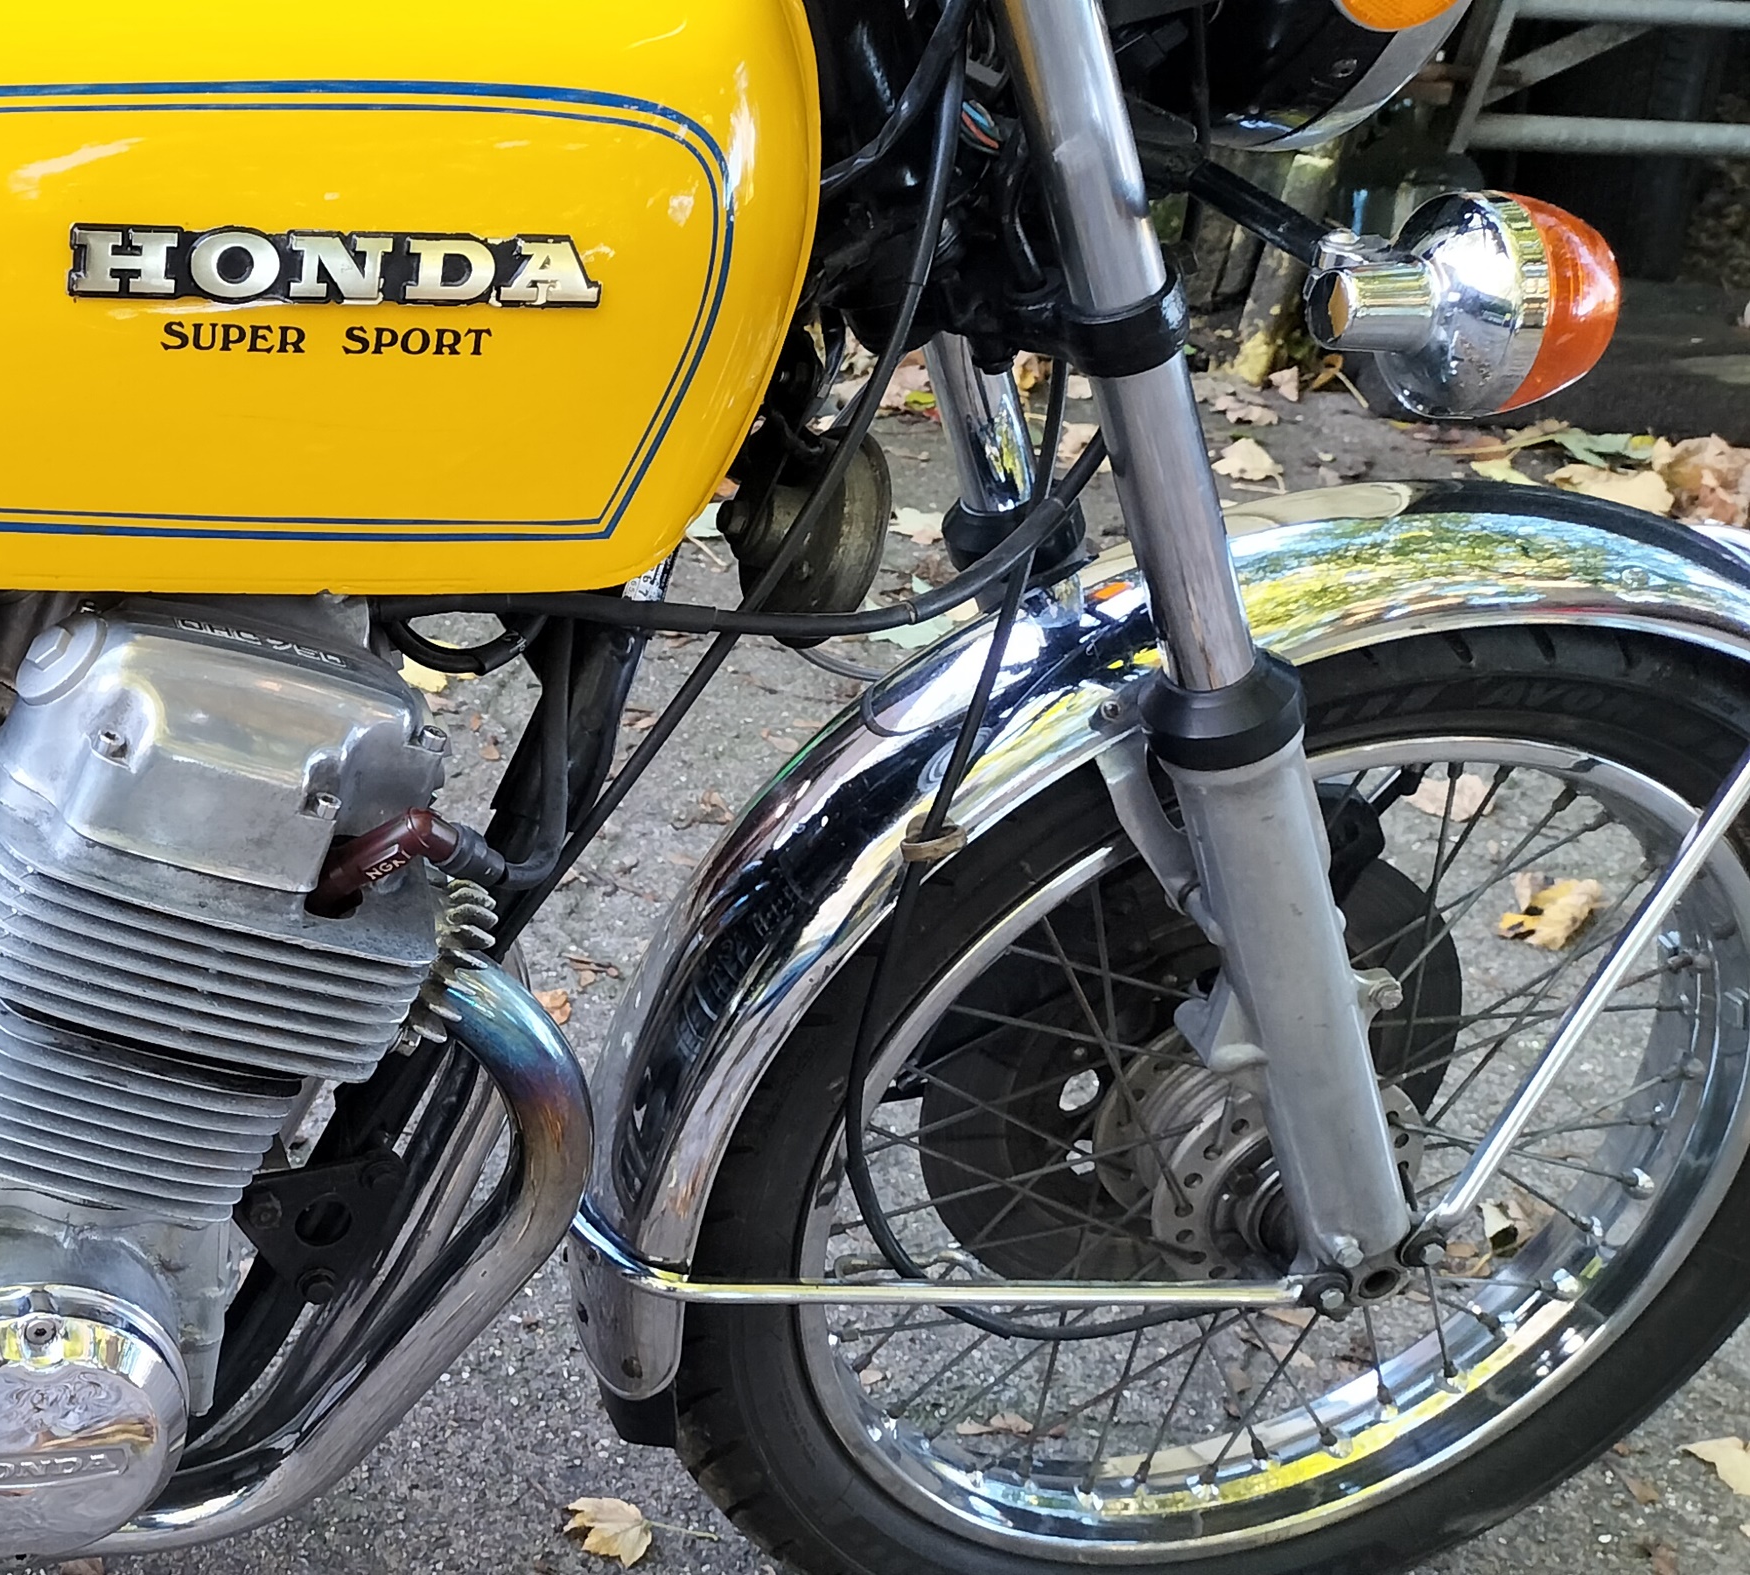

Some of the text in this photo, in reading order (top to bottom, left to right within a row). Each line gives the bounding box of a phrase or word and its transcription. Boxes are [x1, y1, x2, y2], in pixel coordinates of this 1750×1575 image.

[70, 223, 602, 307] HONDA
[161, 321, 492, 356] SUPER SPORT
[365, 858, 407, 880] NGK
